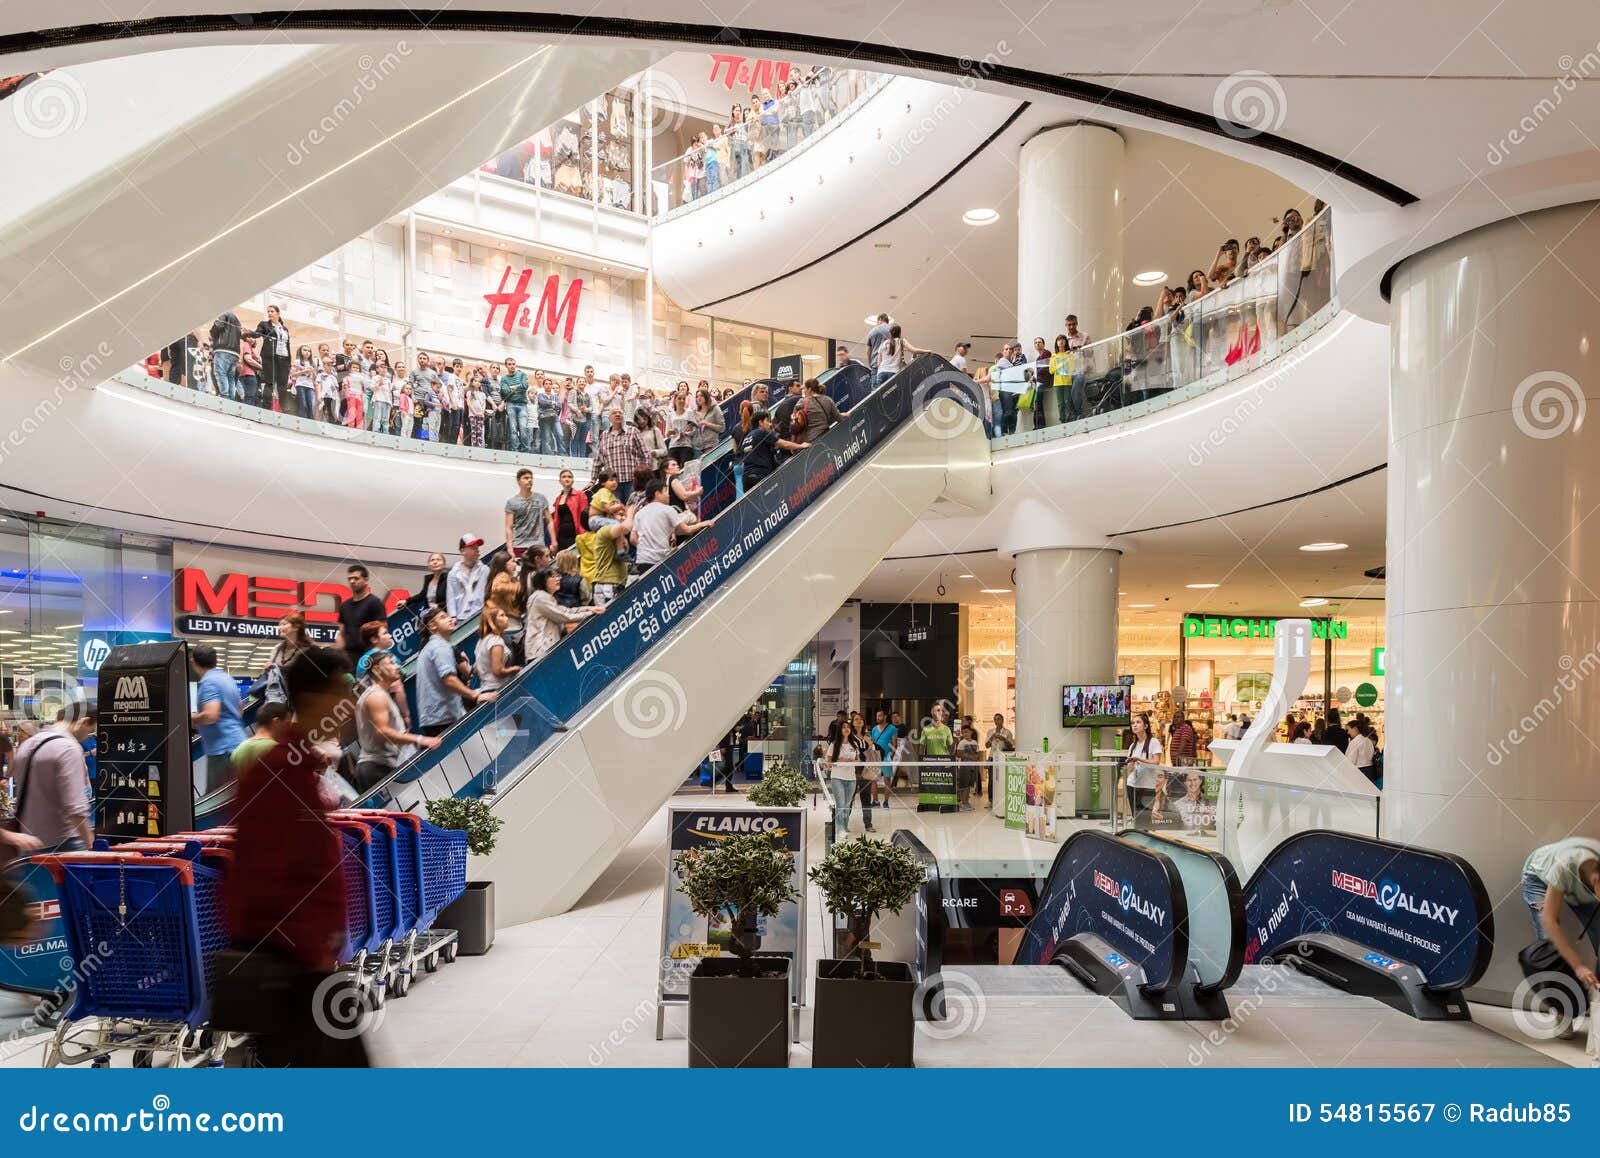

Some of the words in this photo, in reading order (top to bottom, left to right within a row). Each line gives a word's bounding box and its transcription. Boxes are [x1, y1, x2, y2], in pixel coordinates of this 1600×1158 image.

[483, 265, 583, 344] H&M
[638, 615, 661, 643] Să
[661, 557, 722, 624] descoperi
[722, 547, 743, 570] cea
[743, 524, 764, 550] mai
[764, 499, 789, 533] nouă
[843, 435, 861, 463] nivel
[188, 618, 212, 631] LED
[214, 620, 231, 633] TV
[237, 623, 324, 640] SMARTNE
[570, 586, 661, 671] Lansează-te
[659, 574, 676, 595] în
[1184, 617, 1348, 640] DEICHNN
[85, 639, 111, 670] hp
[695, 816, 780, 832] FLANCO
[941, 898, 978, 908] RCARE
[1005, 905, 1012, 913] P
[1332, 869, 1378, 900] MEDIA
[1376, 884, 1459, 927] GALAXY
[1257, 927, 1267, 945] la
[1267, 900, 1290, 933] nivel
[21, 943, 44, 955] CEA
